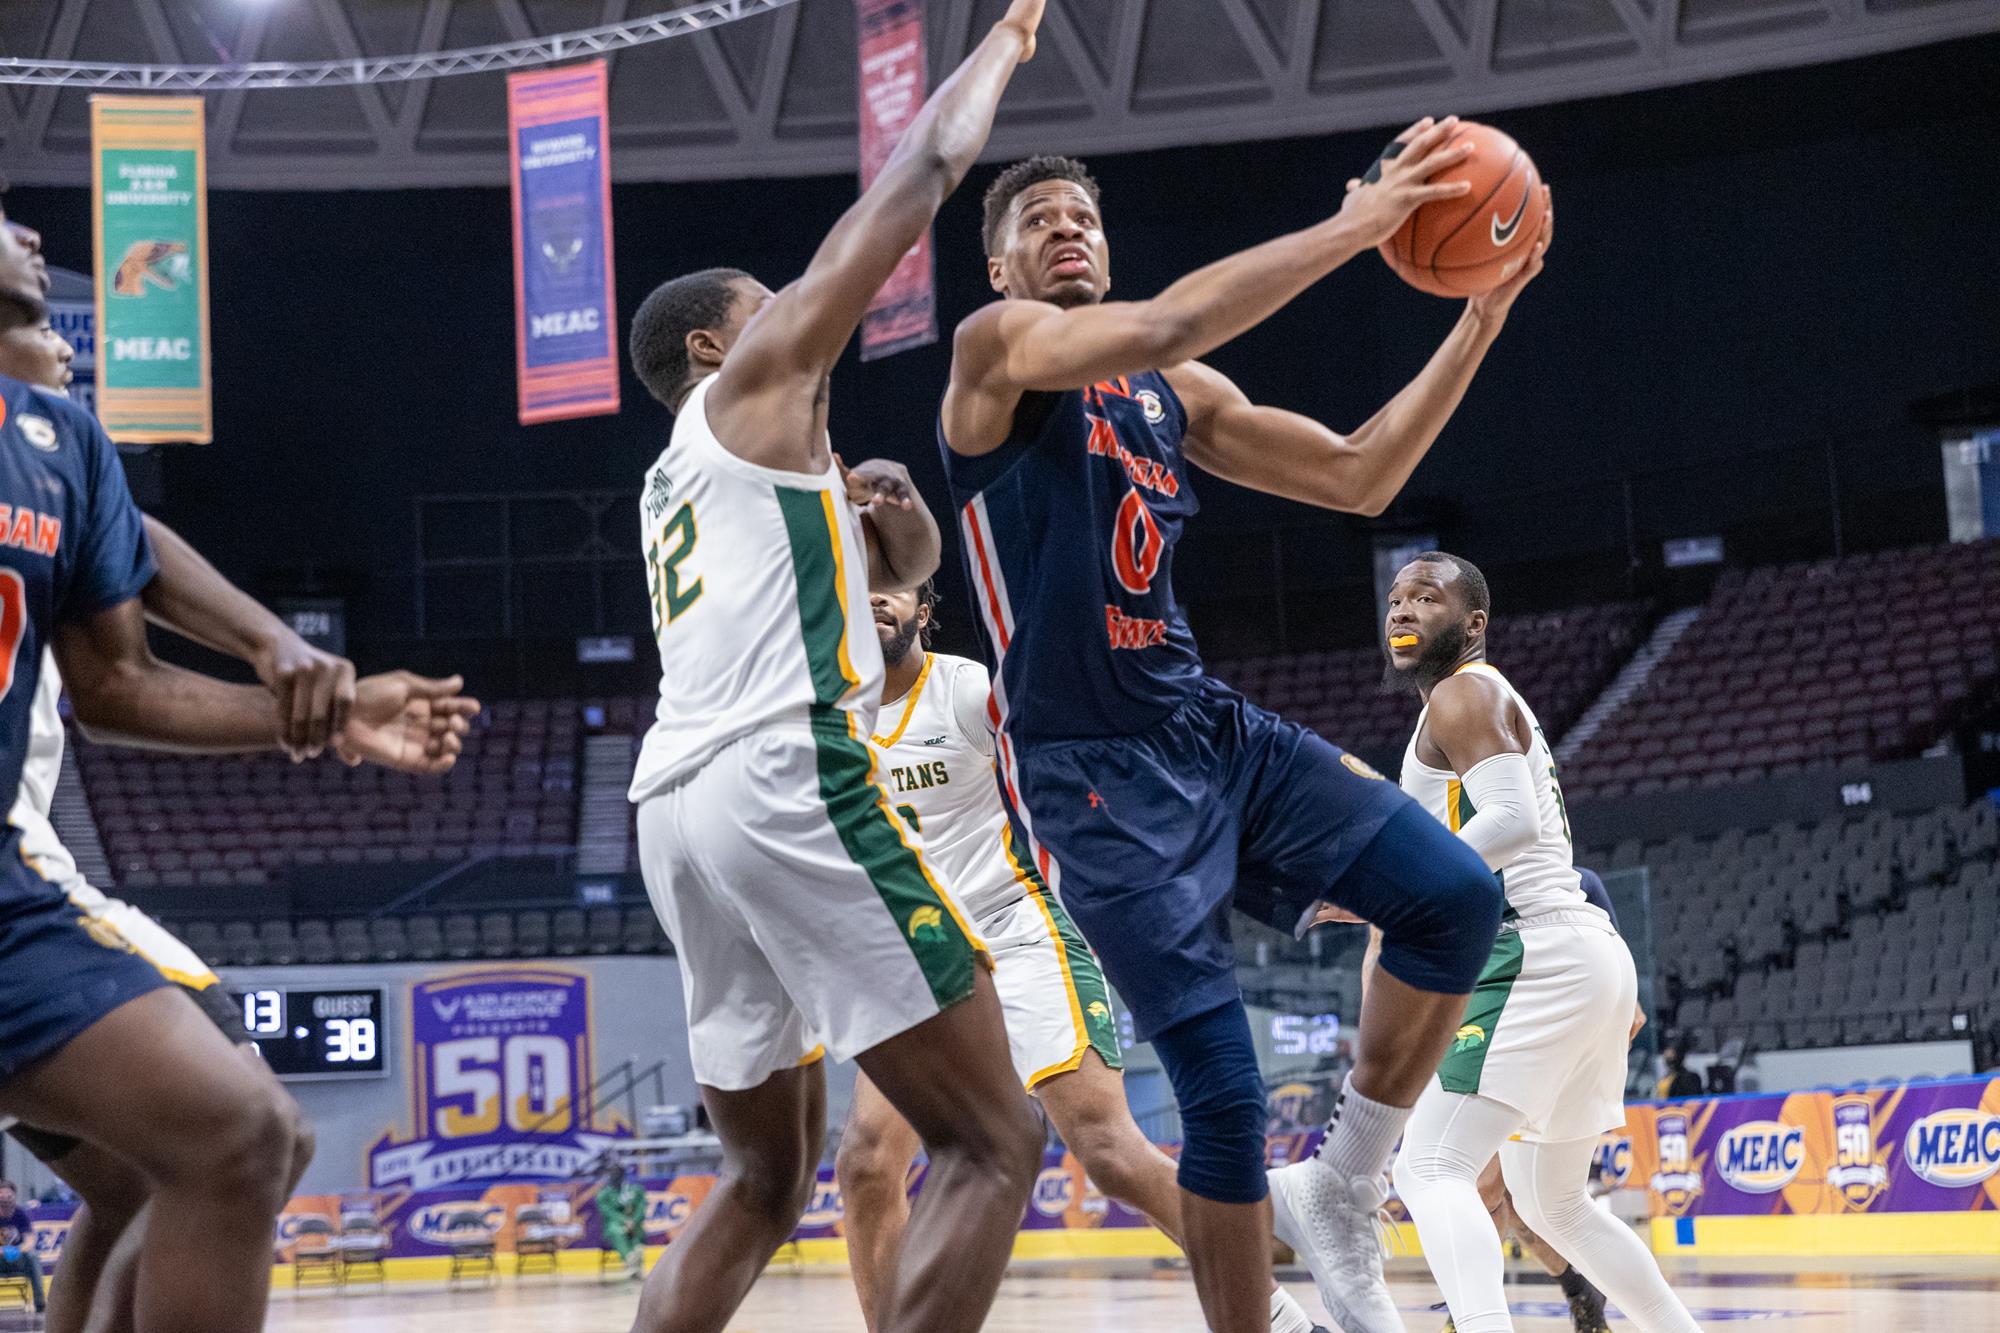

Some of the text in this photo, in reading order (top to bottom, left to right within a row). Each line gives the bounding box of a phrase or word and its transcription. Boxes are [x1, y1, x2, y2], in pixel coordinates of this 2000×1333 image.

[119, 164, 177, 179] FLORIDA
[523, 146, 597, 170] UNIVERSITY
[106, 191, 192, 206] UNIVERSITY
[531, 307, 600, 339] MEAC
[113, 336, 192, 361] MEAC
[1111, 486, 1165, 594] 0
[244, 990, 281, 1032] 13
[313, 994, 373, 1018] GUEST
[325, 1018, 376, 1061] 38
[433, 1034, 572, 1138] 50
[1659, 1134, 1688, 1173] 50
[1727, 1131, 1801, 1172] MEAC
[1838, 1122, 1871, 1167] 50
[1915, 1120, 2000, 1165] MEAC
